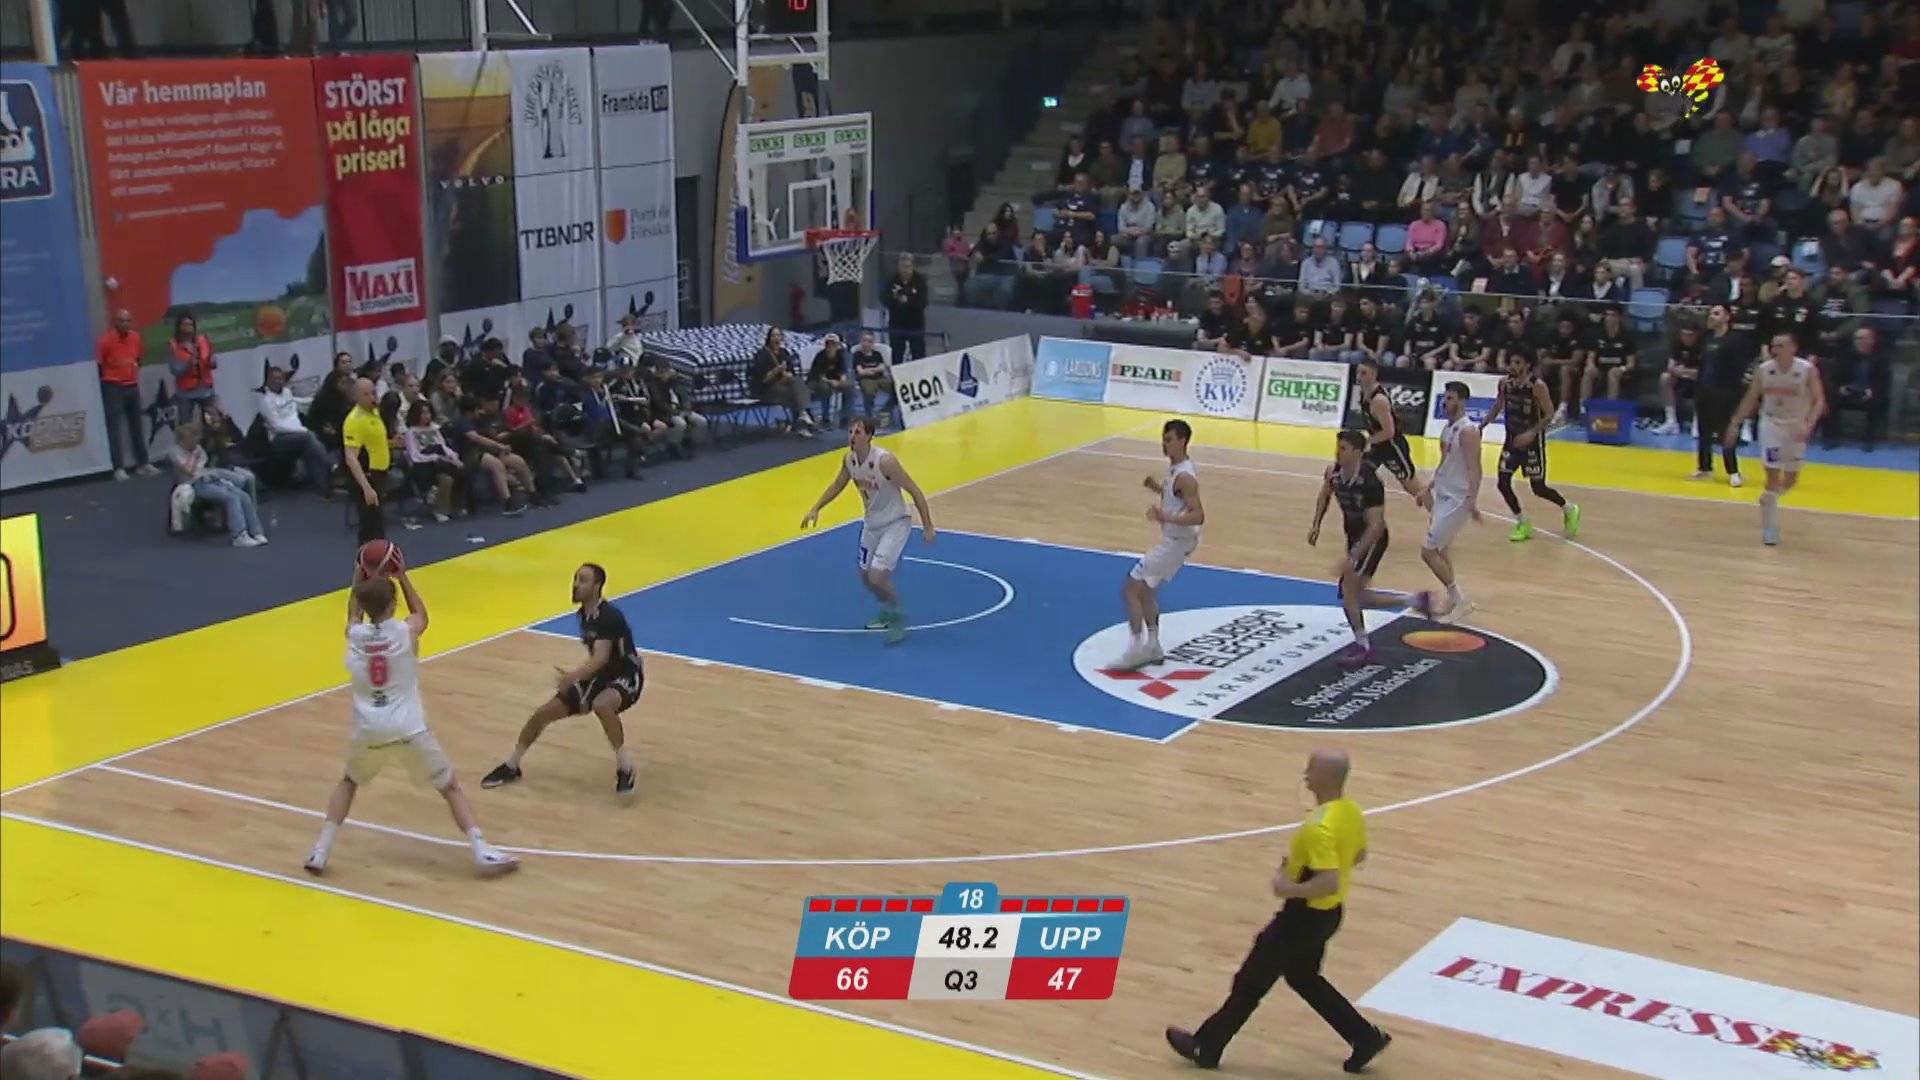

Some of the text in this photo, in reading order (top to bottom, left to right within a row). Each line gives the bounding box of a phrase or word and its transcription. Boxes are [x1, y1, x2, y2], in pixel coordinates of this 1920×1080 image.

[98, 75, 267, 106] Vår hemmaplan
[324, 72, 407, 108] STÖRST
[325, 110, 358, 148] på
[360, 108, 411, 144] låga
[335, 143, 406, 180] priser!
[0, 165, 40, 189] RA
[440, 175, 504, 189] VOLVO
[520, 221, 594, 250] TIBNOR
[1204, 383, 1240, 402] KW
[1302, 400, 1338, 415] kedjan
[1194, 621, 1305, 668] ELECTRIC
